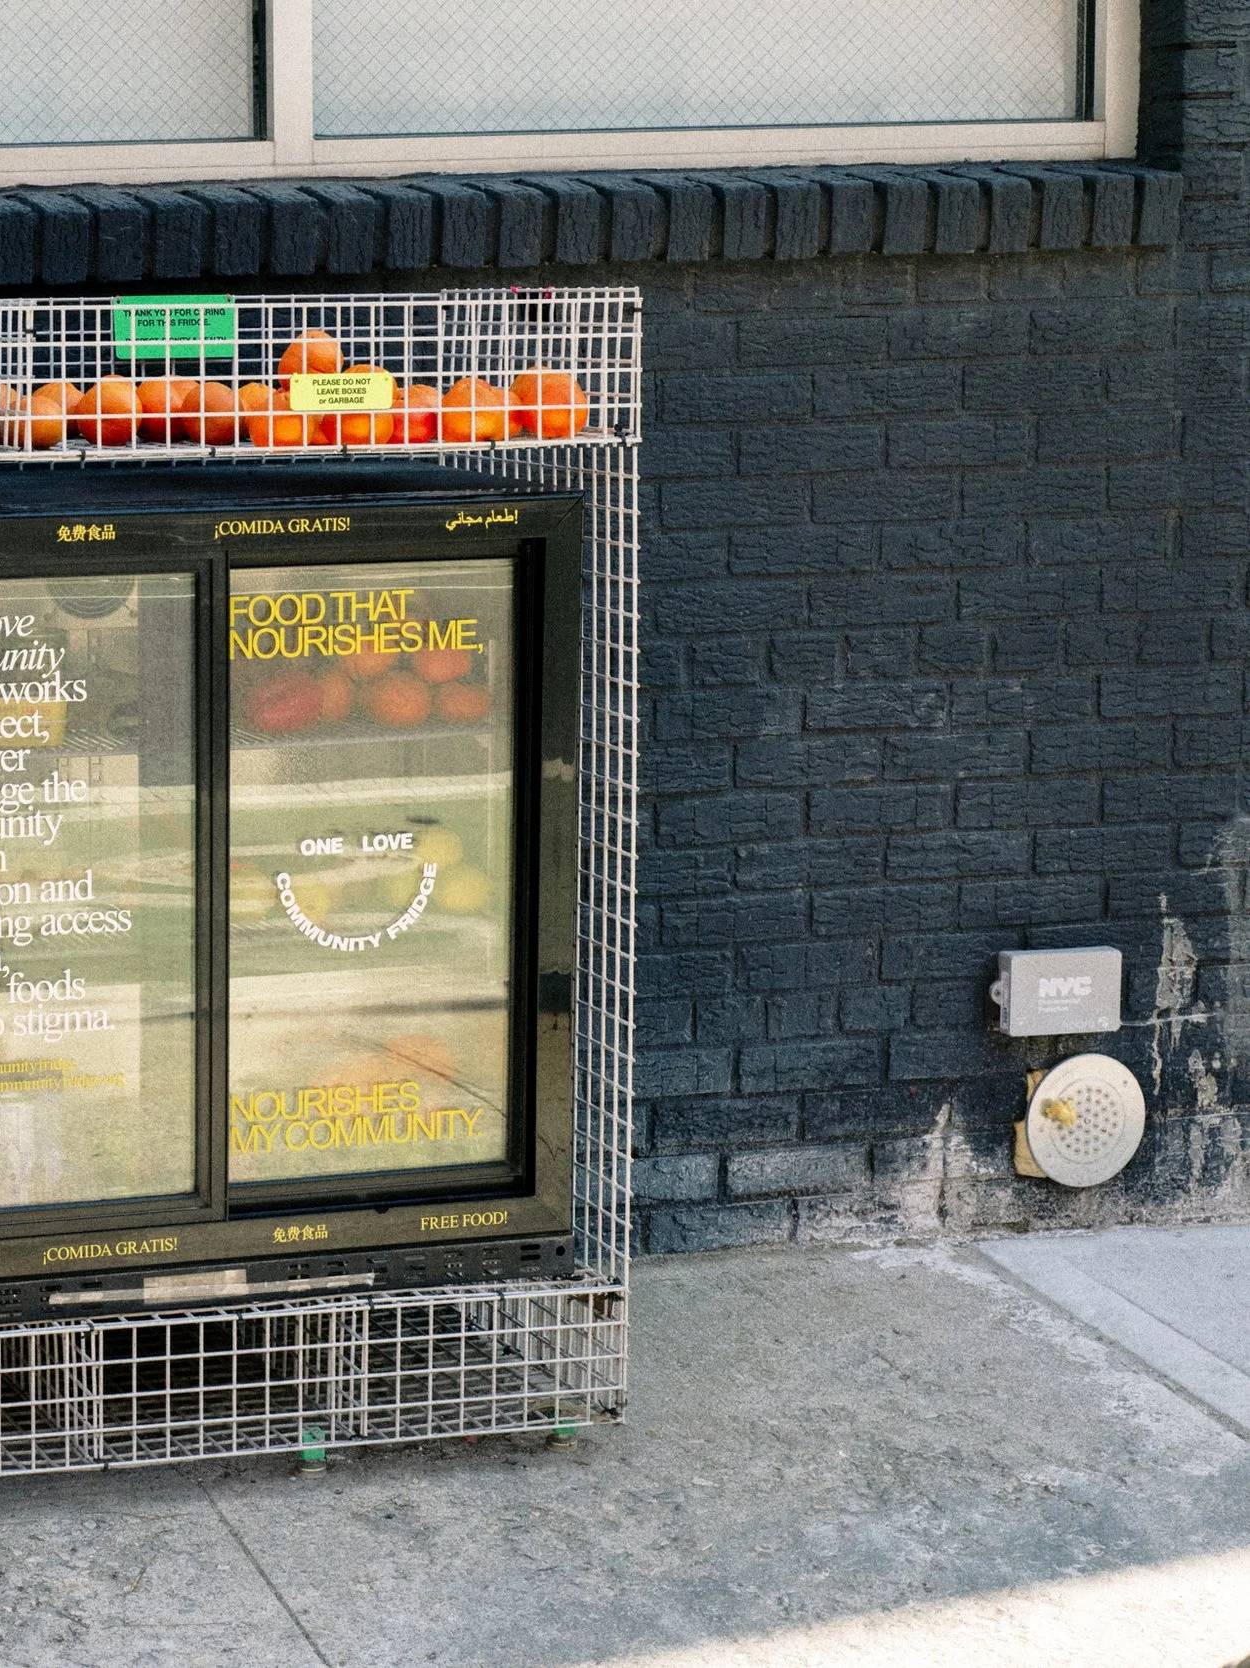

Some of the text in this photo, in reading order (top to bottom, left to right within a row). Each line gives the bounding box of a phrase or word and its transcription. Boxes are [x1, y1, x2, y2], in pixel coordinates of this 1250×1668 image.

[137, 319, 155, 327] FOR
[156, 319, 176, 327] THS
[175, 308, 192, 316] FOR
[194, 308, 226, 316] CRING
[312, 378, 341, 386] PLEASE
[342, 378, 354, 386] DO
[341, 387, 367, 395] BOXES
[56, 524, 116, 543] 免费食品
[214, 517, 350, 540] ¡COMIDA GRATIS!
[230, 590, 415, 627] FOOD THAT
[230, 619, 484, 660] NOURISHES ME,
[42, 771, 87, 803] the
[300, 833, 414, 857] ONE LOVE
[40, 869, 94, 901] and
[276, 862, 438, 952] COMMUNITY FRIDGE
[40, 908, 132, 936] access
[8, 969, 86, 1004] foods
[1038, 976, 1092, 997] NYC
[13, 1003, 116, 1042] stigma.
[230, 1081, 421, 1123] NOURISHES
[230, 1109, 483, 1155] MY COMMUNITY.
[273, 1224, 328, 1244] 免费食品
[420, 1210, 508, 1231] FREE FOOD!
[42, 1237, 178, 1265] ¡COMIDA GRATIS!
